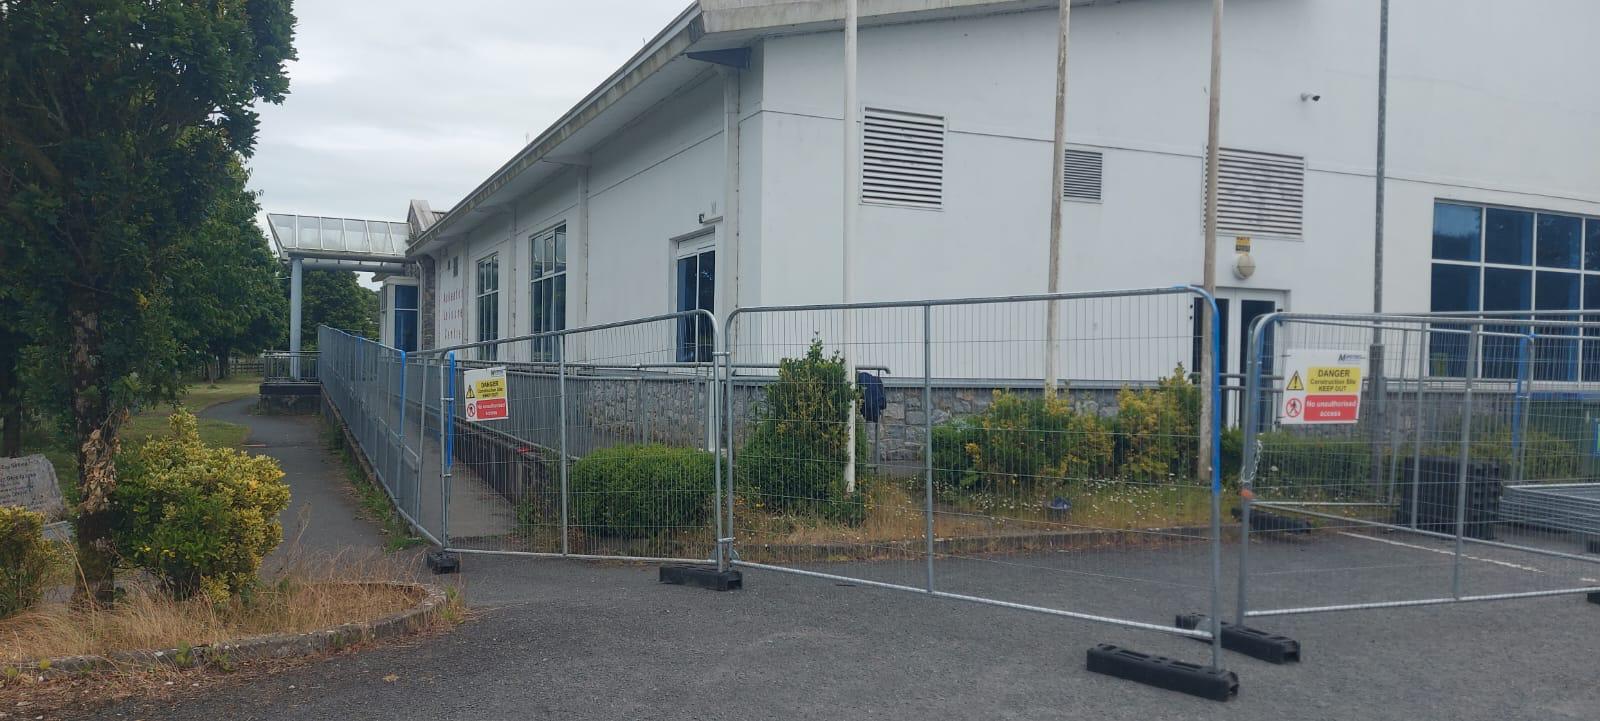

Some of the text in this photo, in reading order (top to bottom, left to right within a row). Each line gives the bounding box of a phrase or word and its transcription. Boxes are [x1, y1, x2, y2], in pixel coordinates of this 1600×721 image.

[1318, 369, 1351, 378] DANGER
[1306, 400, 1357, 408] No unauthorised
